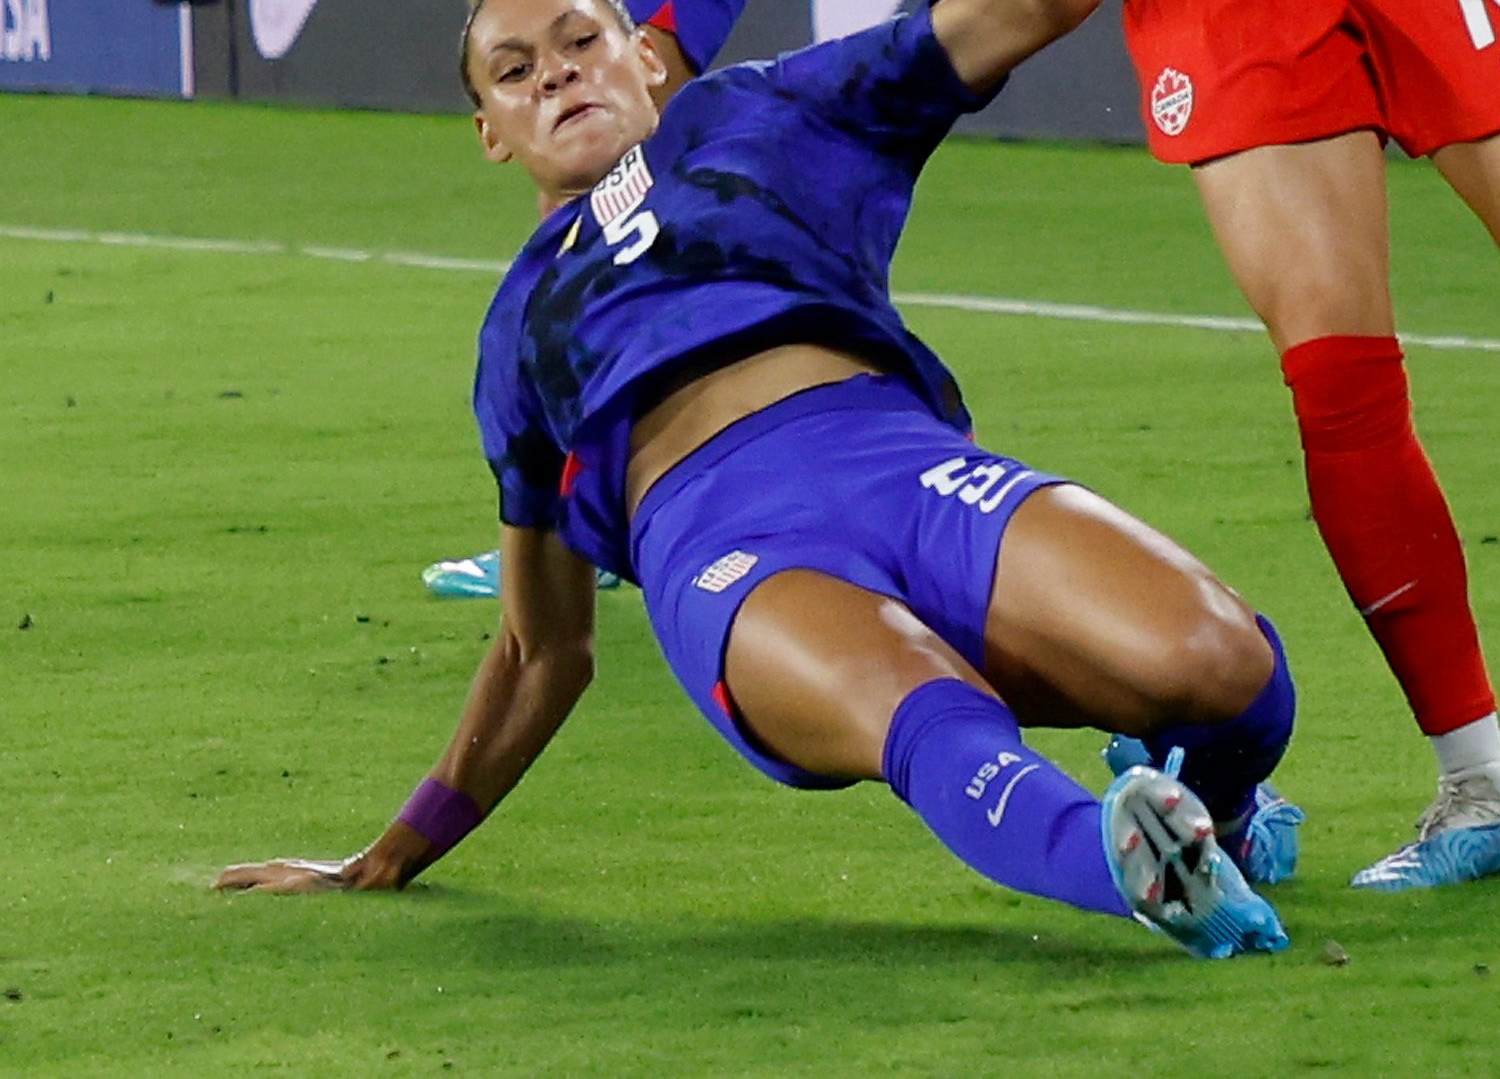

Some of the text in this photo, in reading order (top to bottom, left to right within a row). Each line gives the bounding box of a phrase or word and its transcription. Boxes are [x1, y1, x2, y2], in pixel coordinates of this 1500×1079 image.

[1155, 91, 1189, 115] CANADA
[603, 209, 660, 266] 5
[964, 751, 1021, 800] USA
